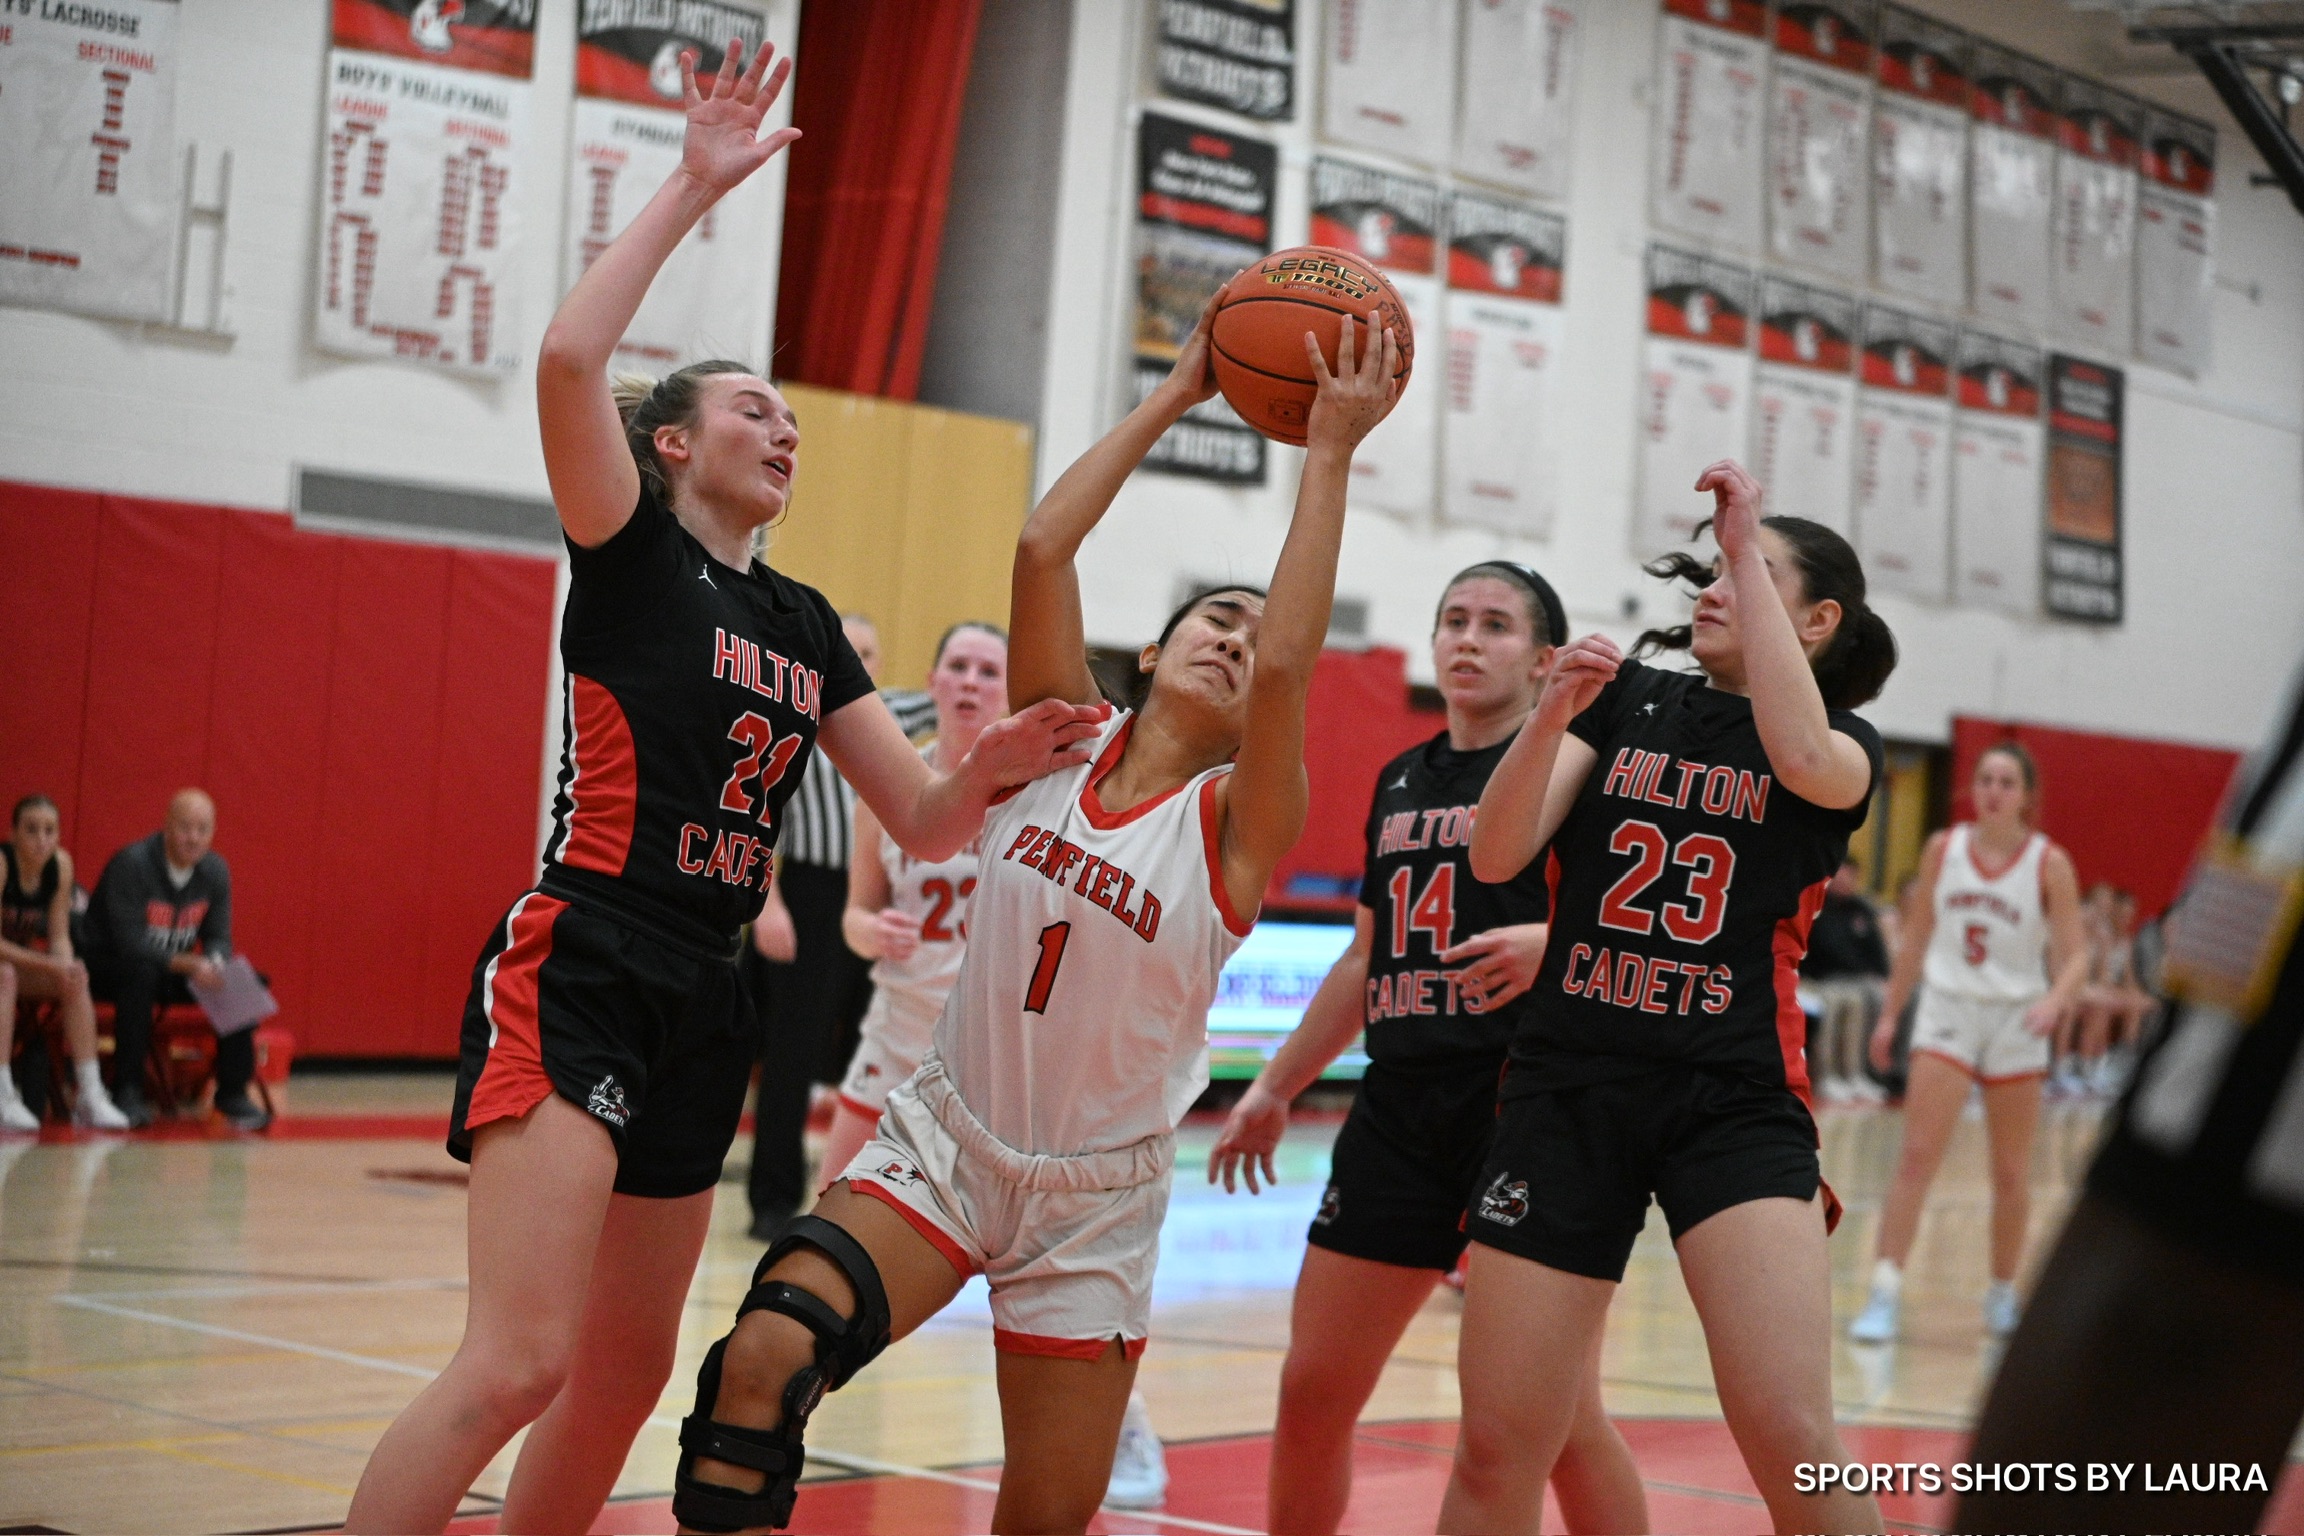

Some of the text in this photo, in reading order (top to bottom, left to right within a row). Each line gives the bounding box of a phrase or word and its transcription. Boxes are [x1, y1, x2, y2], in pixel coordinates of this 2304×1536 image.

[40, 0, 141, 38] LACROSSE
[78, 40, 156, 73] SECTIONAL
[1260, 257, 1379, 294] LEGACY
[1291, 272, 1365, 300] 1000
[712, 626, 825, 726] HILTON
[719, 710, 803, 829] 21
[1602, 746, 1771, 824] HILTON
[1002, 823, 1162, 944] PENFIELD
[1388, 861, 1456, 959] 14
[1598, 818, 1737, 946] 23
[1023, 920, 1071, 1016] 1
[1562, 942, 1733, 1017] CADETS
[1964, 922, 1989, 967] 5
[1481, 1205, 1517, 1225] CADETS
